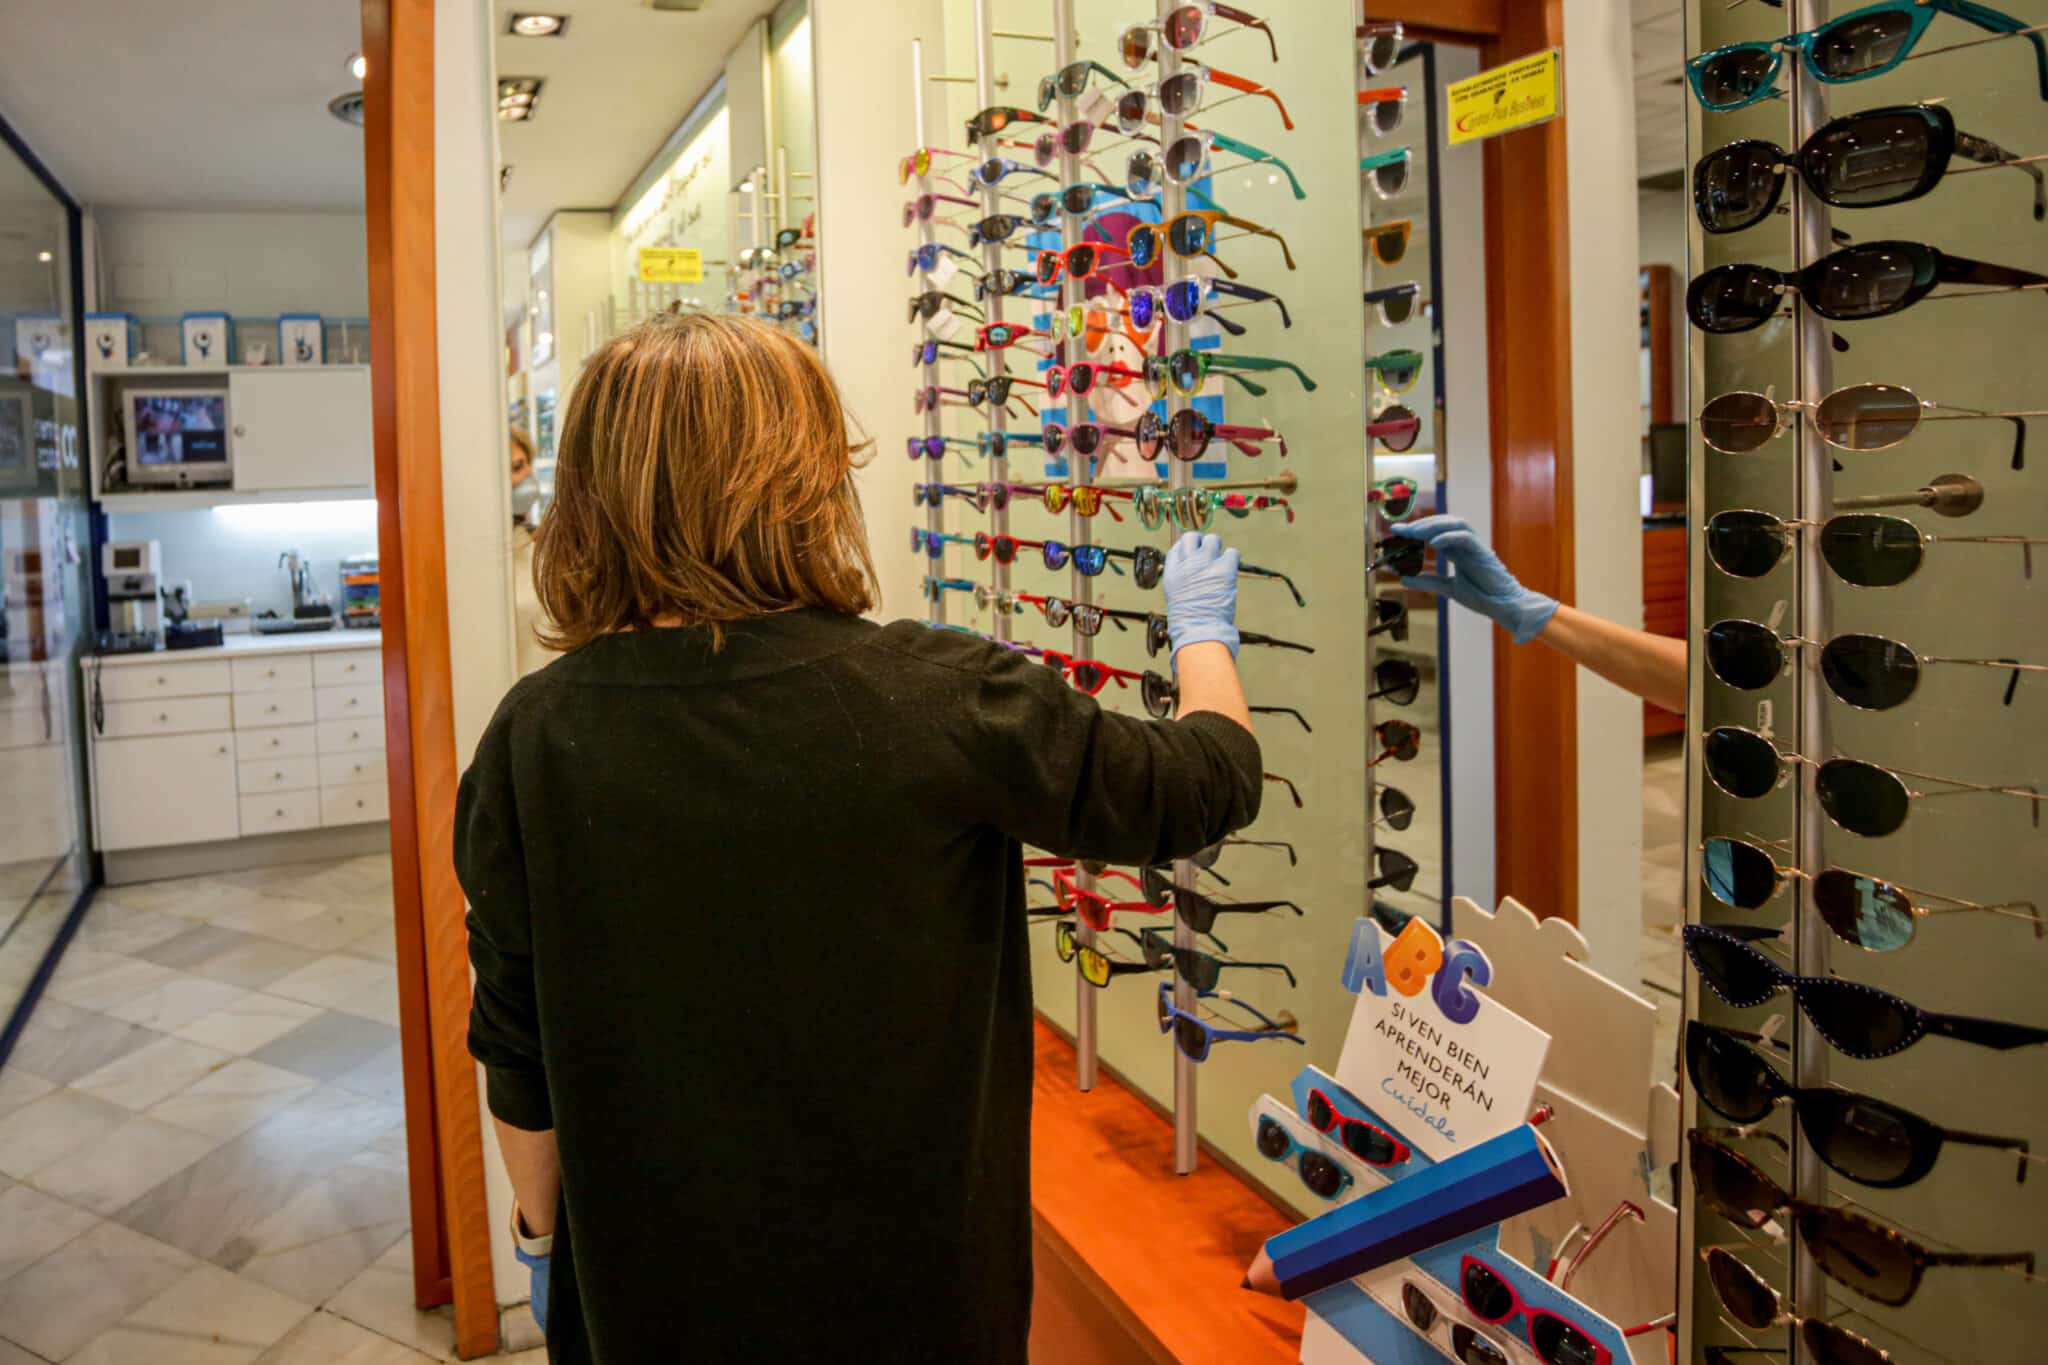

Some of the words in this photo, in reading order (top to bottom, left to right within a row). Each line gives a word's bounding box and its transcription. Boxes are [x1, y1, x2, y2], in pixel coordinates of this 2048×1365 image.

[1342, 916, 1493, 1024] ABC
[1375, 1018, 1494, 1112] APRENDERÁN
[1391, 1002, 1406, 1019] SI
[1409, 1012, 1443, 1046] VEN
[1447, 1040, 1490, 1079] BIEN
[1397, 1059, 1451, 1111] MEJOR
